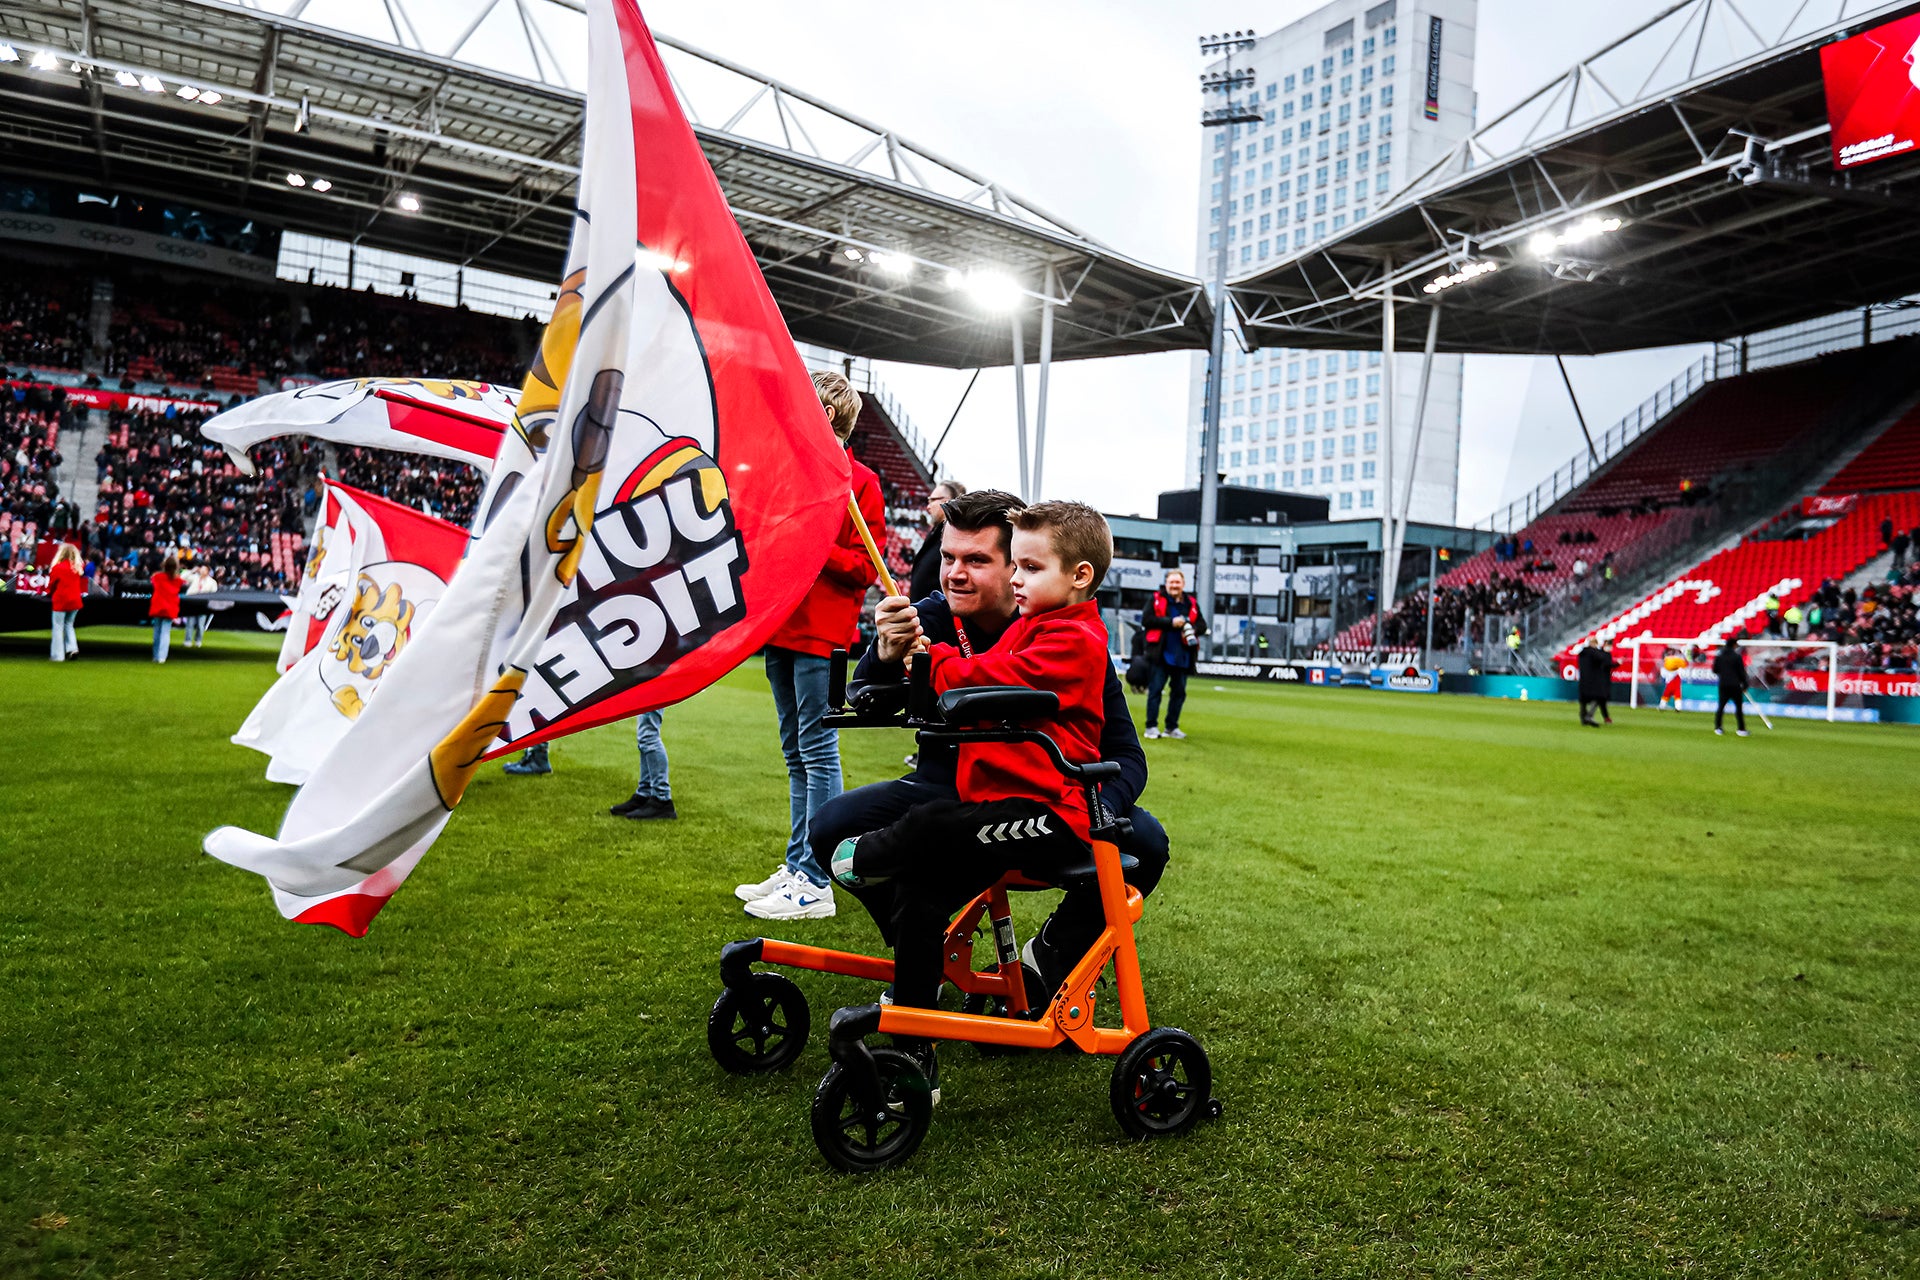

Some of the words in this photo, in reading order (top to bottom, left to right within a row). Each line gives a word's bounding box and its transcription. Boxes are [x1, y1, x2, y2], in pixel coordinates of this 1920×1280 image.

[1428, 20, 1440, 98] CONCLUSION
[1, 216, 55, 235] oppo
[79, 227, 135, 247] oppo
[155, 239, 208, 260] oppo
[957, 628, 967, 642] FC
